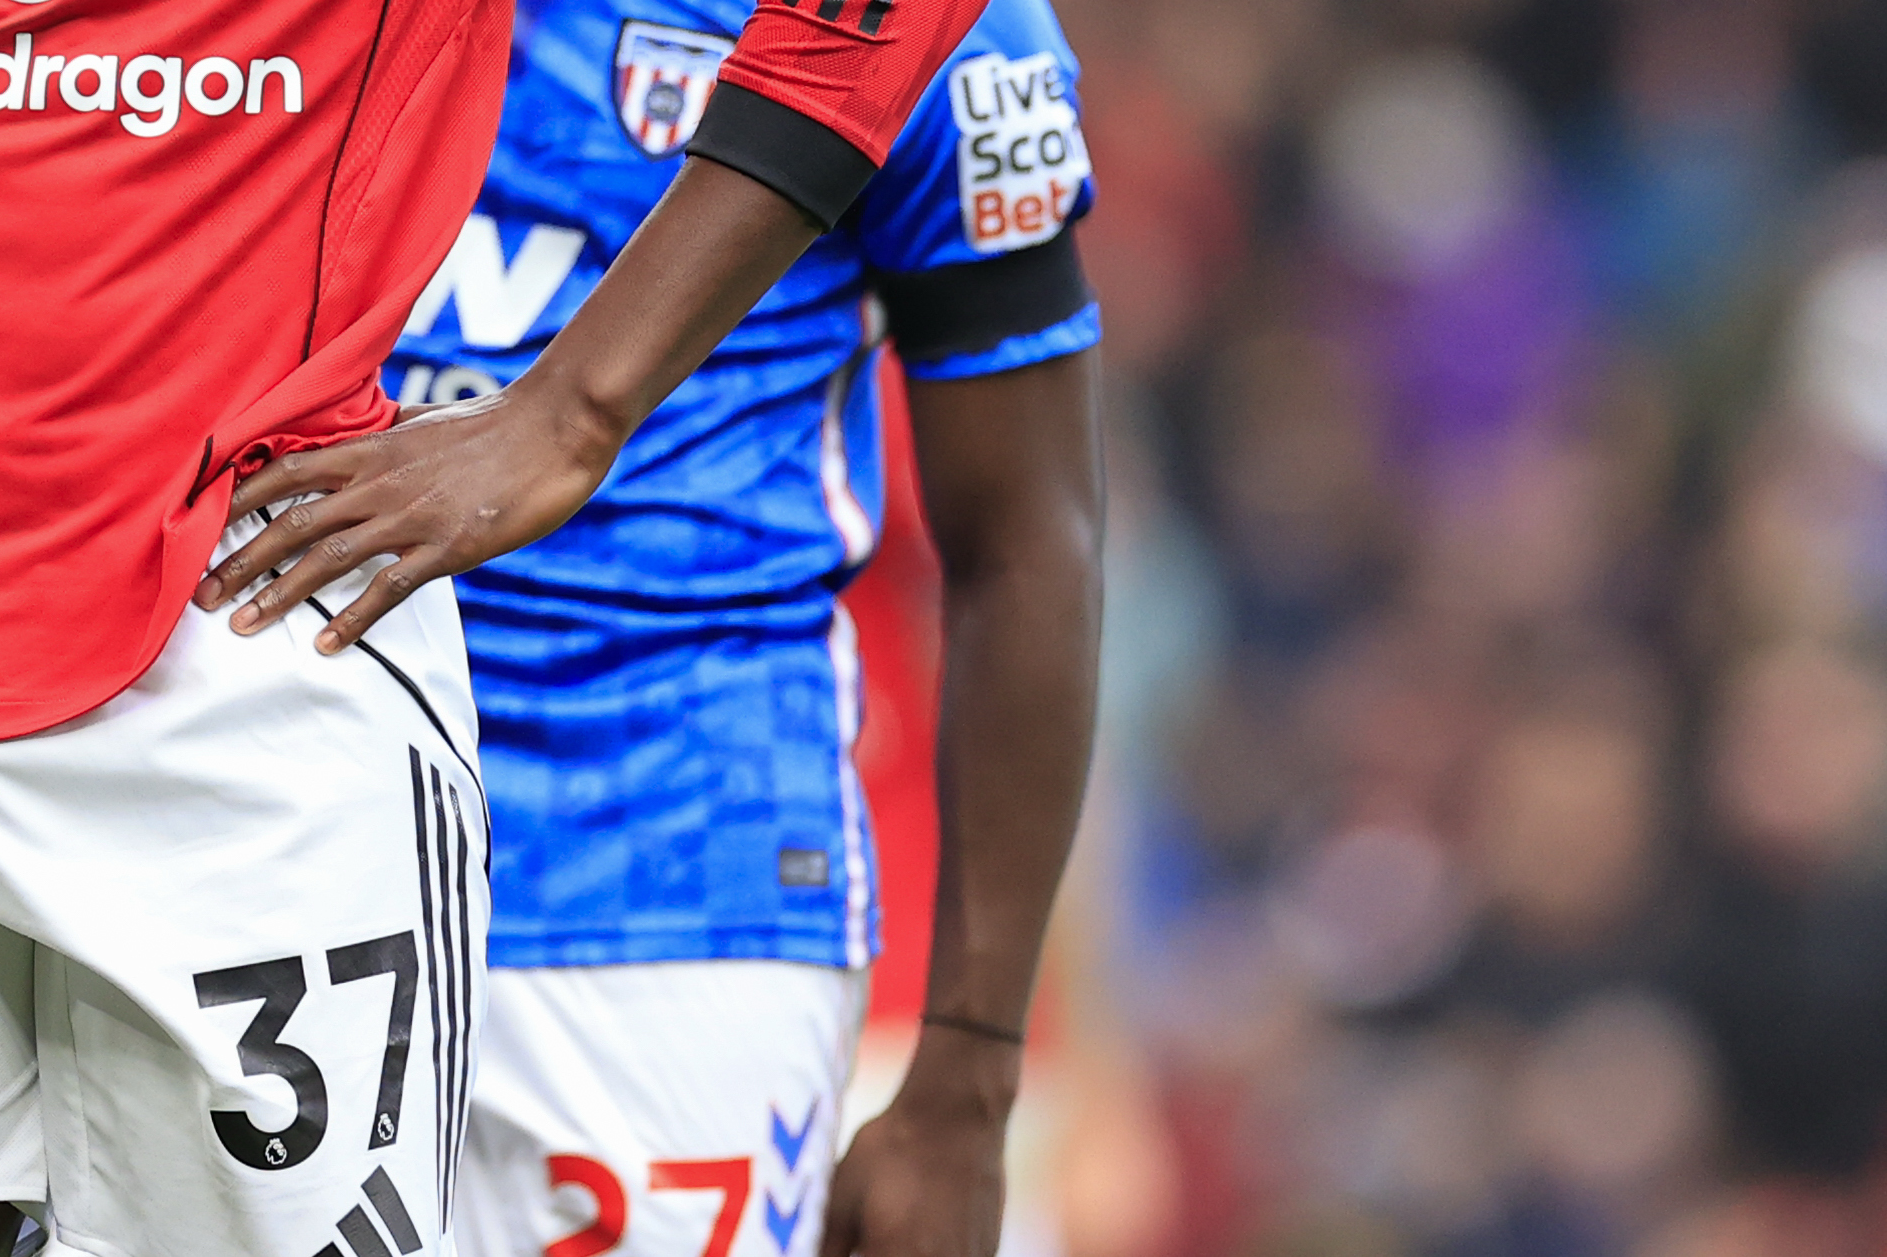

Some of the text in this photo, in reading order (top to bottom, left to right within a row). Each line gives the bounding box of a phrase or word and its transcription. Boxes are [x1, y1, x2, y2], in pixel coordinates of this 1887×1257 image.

[961, 66, 1065, 123] Live
[970, 128, 1072, 183] Sco
[974, 179, 1066, 240] Bet
[192, 929, 420, 1172] 37
[542, 1154, 752, 1257] 27
